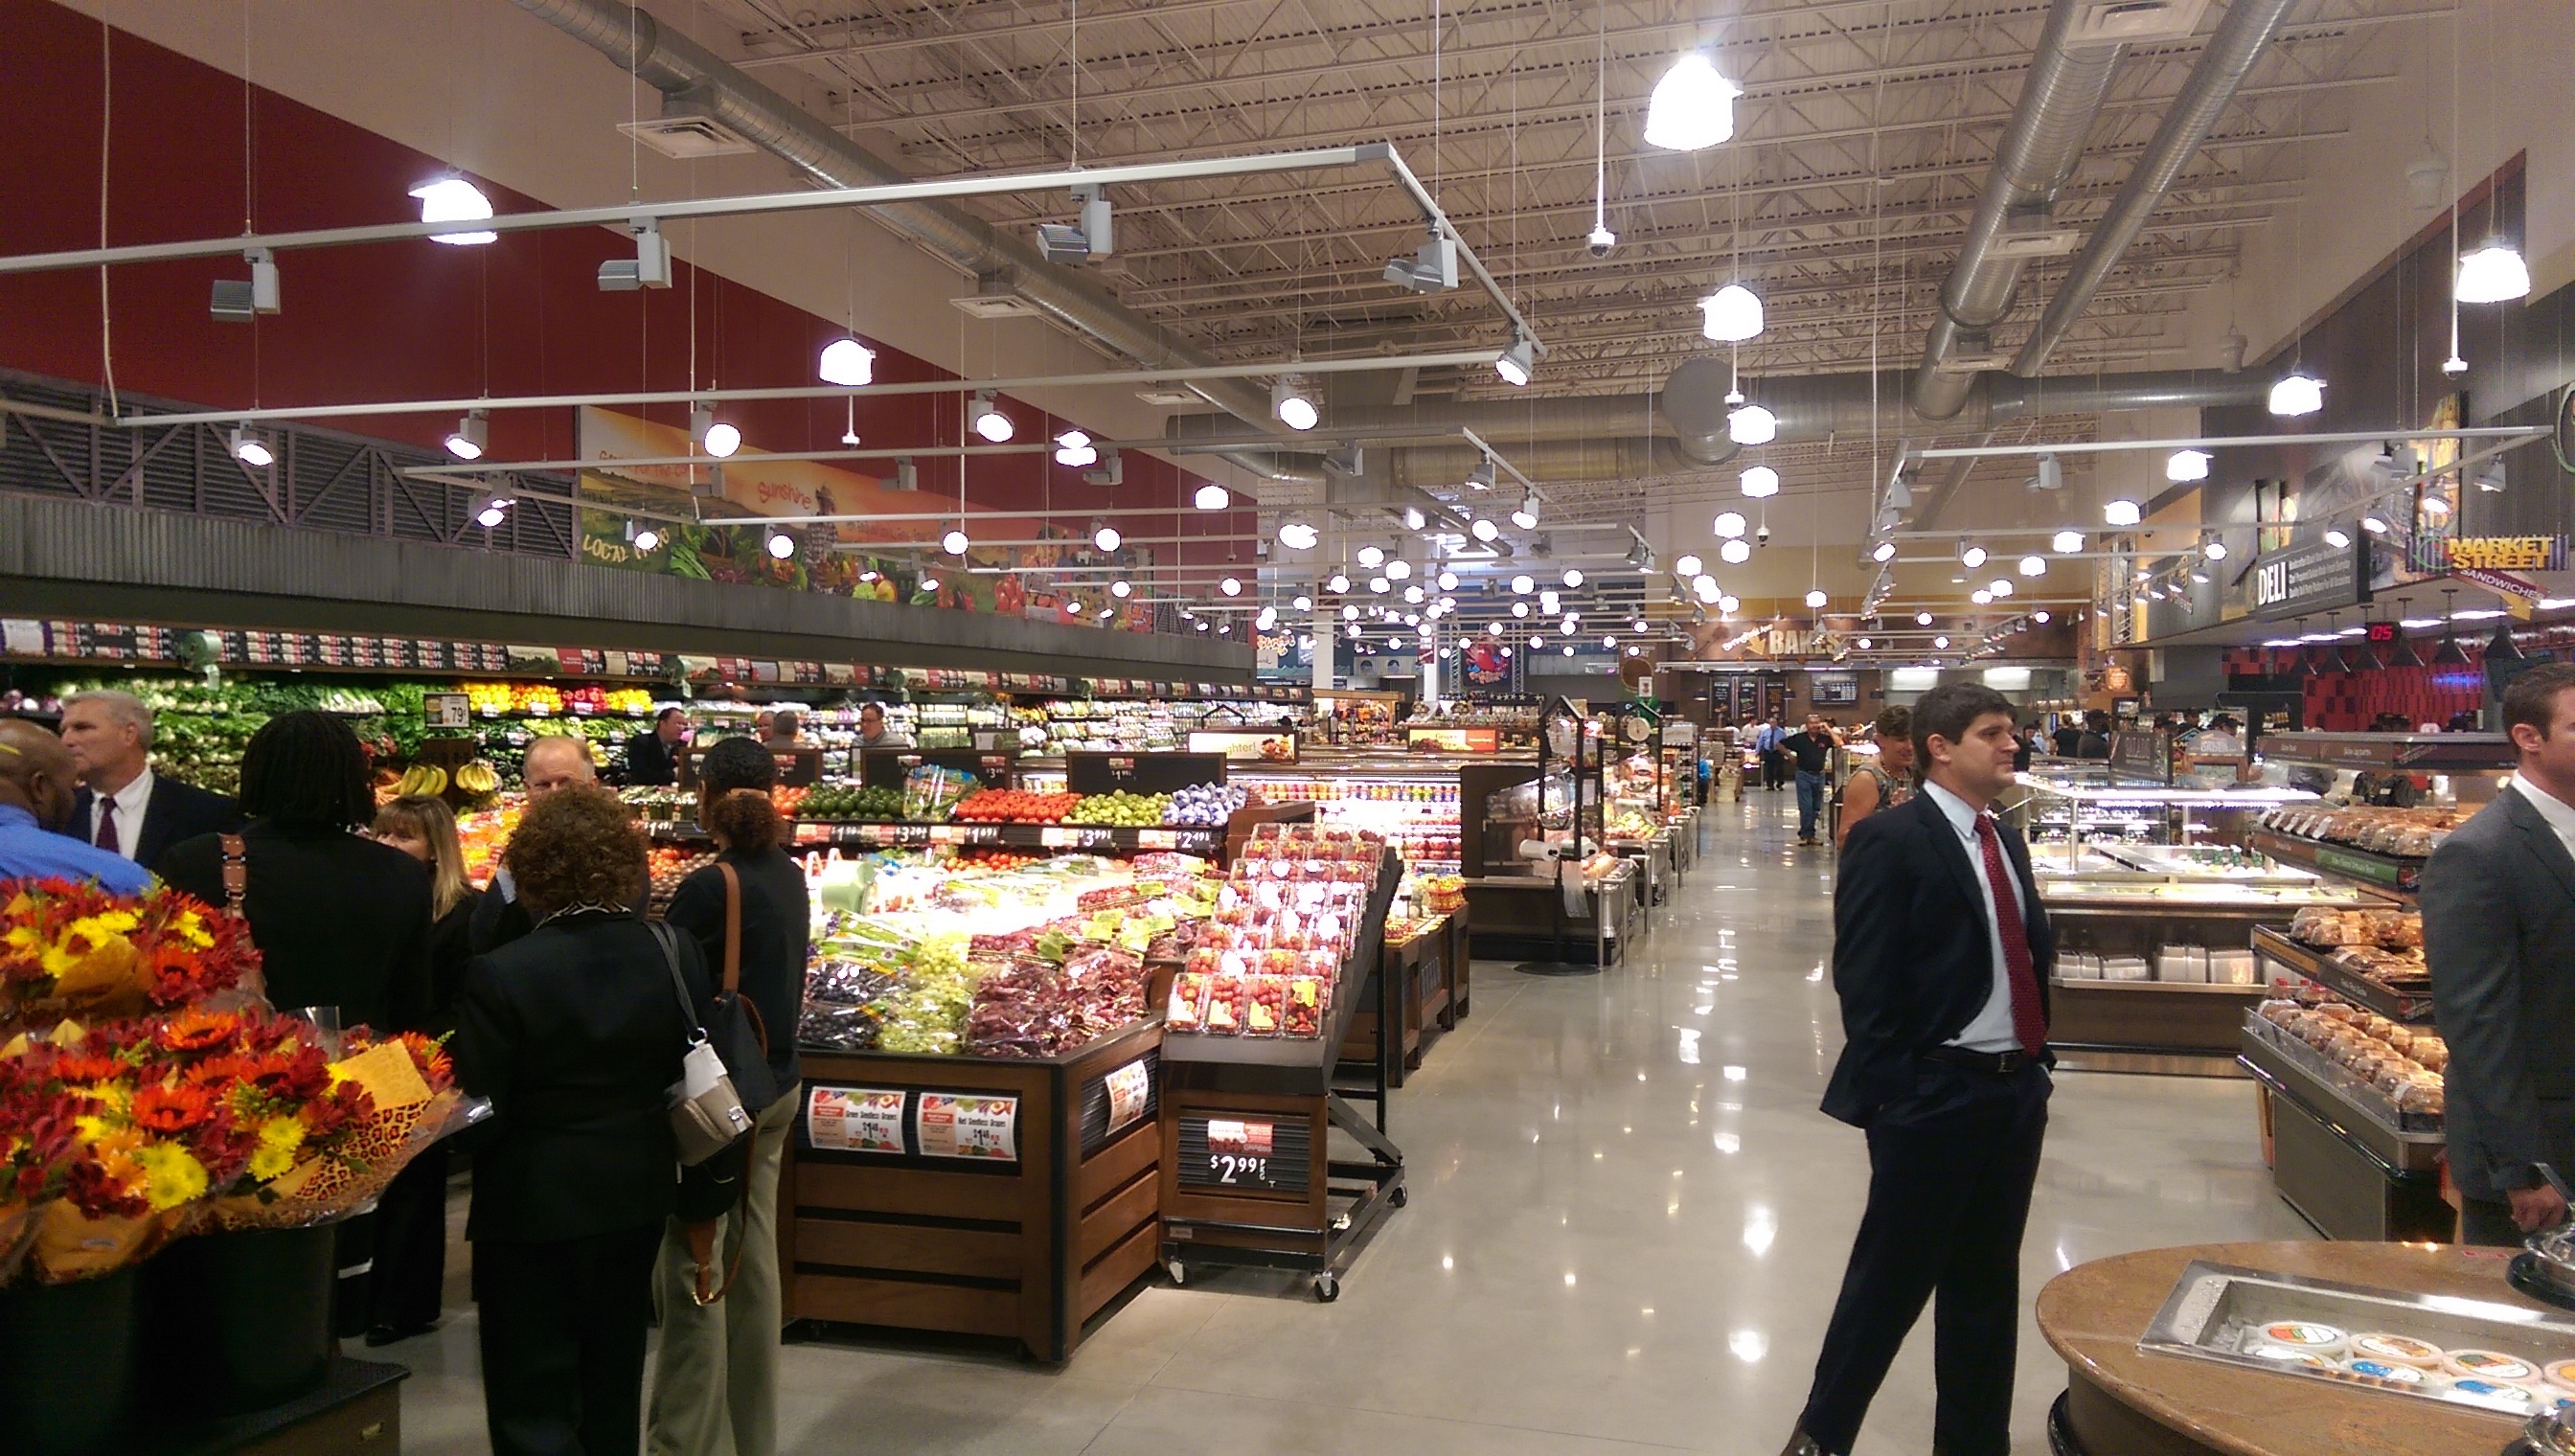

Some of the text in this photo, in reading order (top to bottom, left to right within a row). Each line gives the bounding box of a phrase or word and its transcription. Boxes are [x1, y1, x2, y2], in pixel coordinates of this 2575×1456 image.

[758, 481, 811, 510] Sunshine
[582, 534, 628, 563] LOCAL
[2449, 536, 2555, 555] MARKET
[2451, 553, 2550, 569] STREET
[2258, 561, 2287, 605] DELI
[2460, 569, 2548, 601] SANDWICHES
[2371, 625, 2392, 641] 05
[1225, 741, 1257, 756] ghter!
